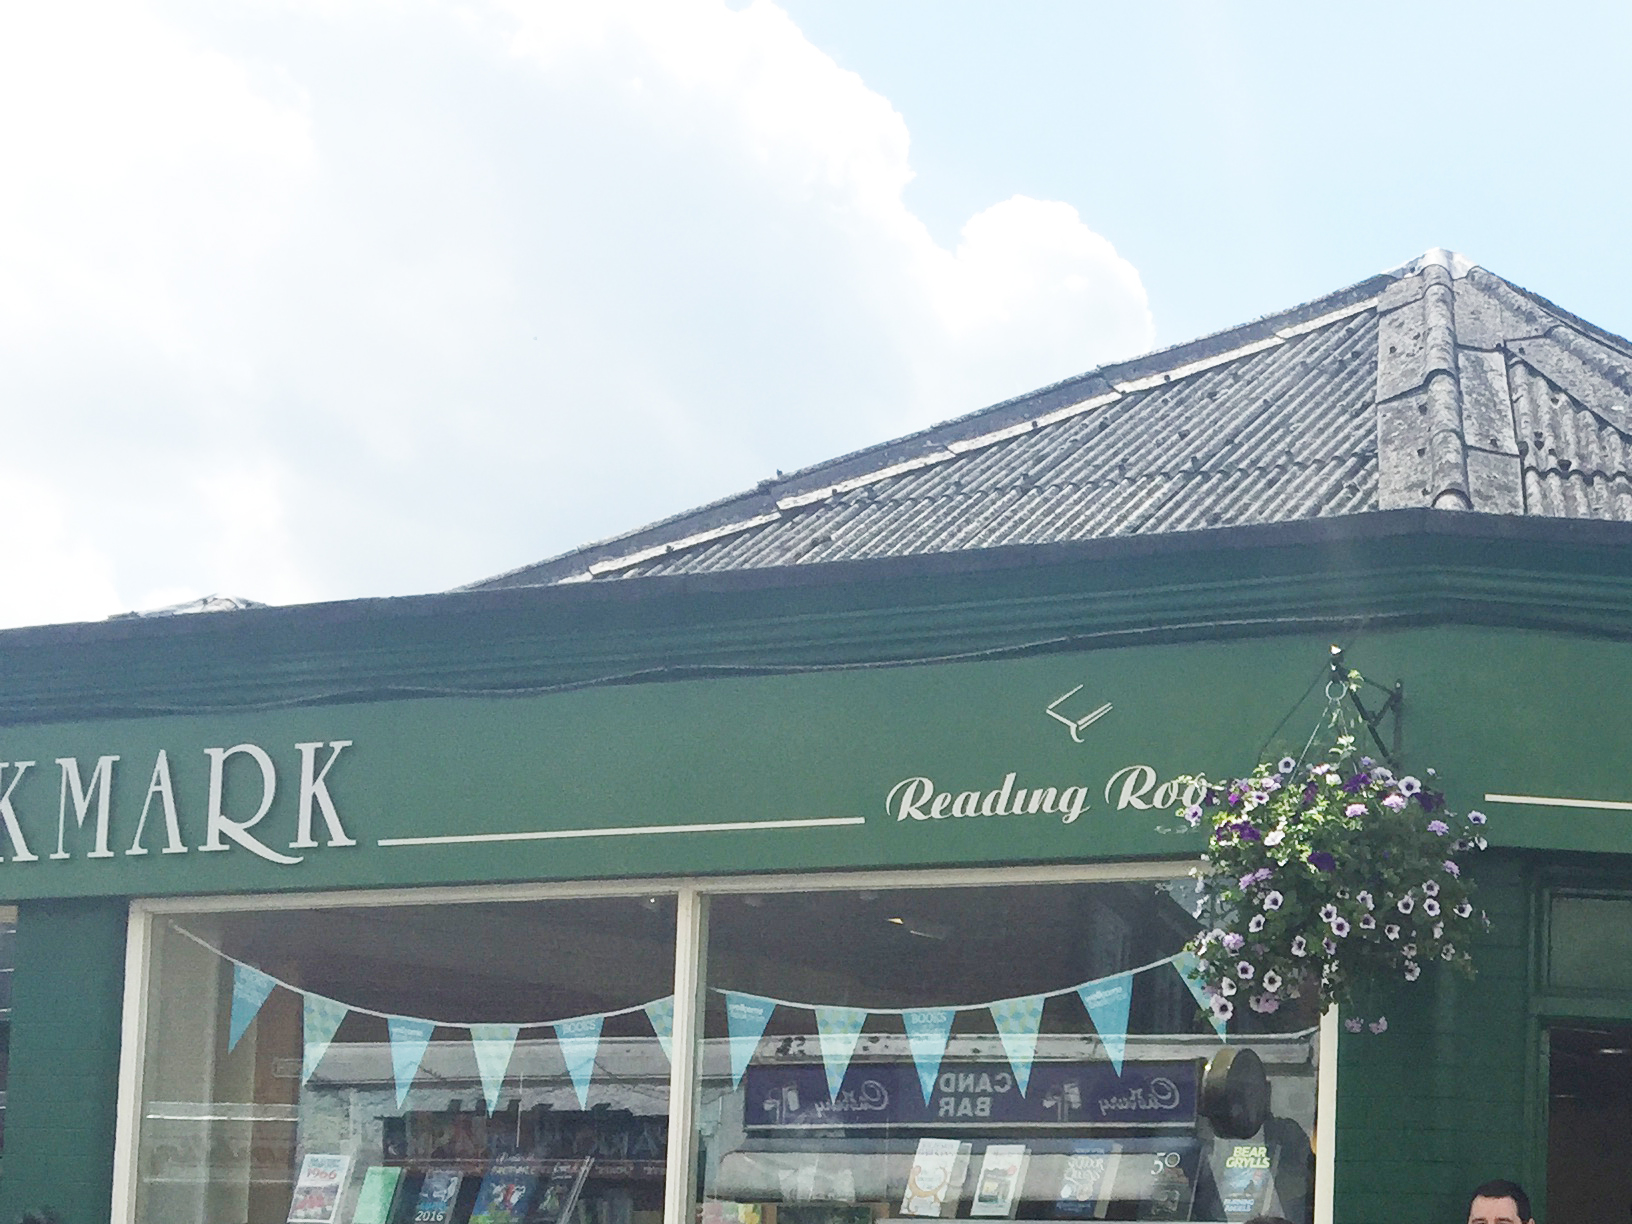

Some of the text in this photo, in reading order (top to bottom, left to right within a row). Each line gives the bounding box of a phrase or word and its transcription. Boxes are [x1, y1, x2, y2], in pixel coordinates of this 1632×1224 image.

[885, 764, 1207, 824] Reading Roo
[911, 1012, 947, 1024] BOOKS
[1232, 1146, 1268, 1158] BEAR
[1150, 1152, 1181, 1175] 50
[1225, 1156, 1271, 1169] GRYLLS
[306, 1166, 338, 1180] 1966
[415, 1210, 446, 1222] 2016
